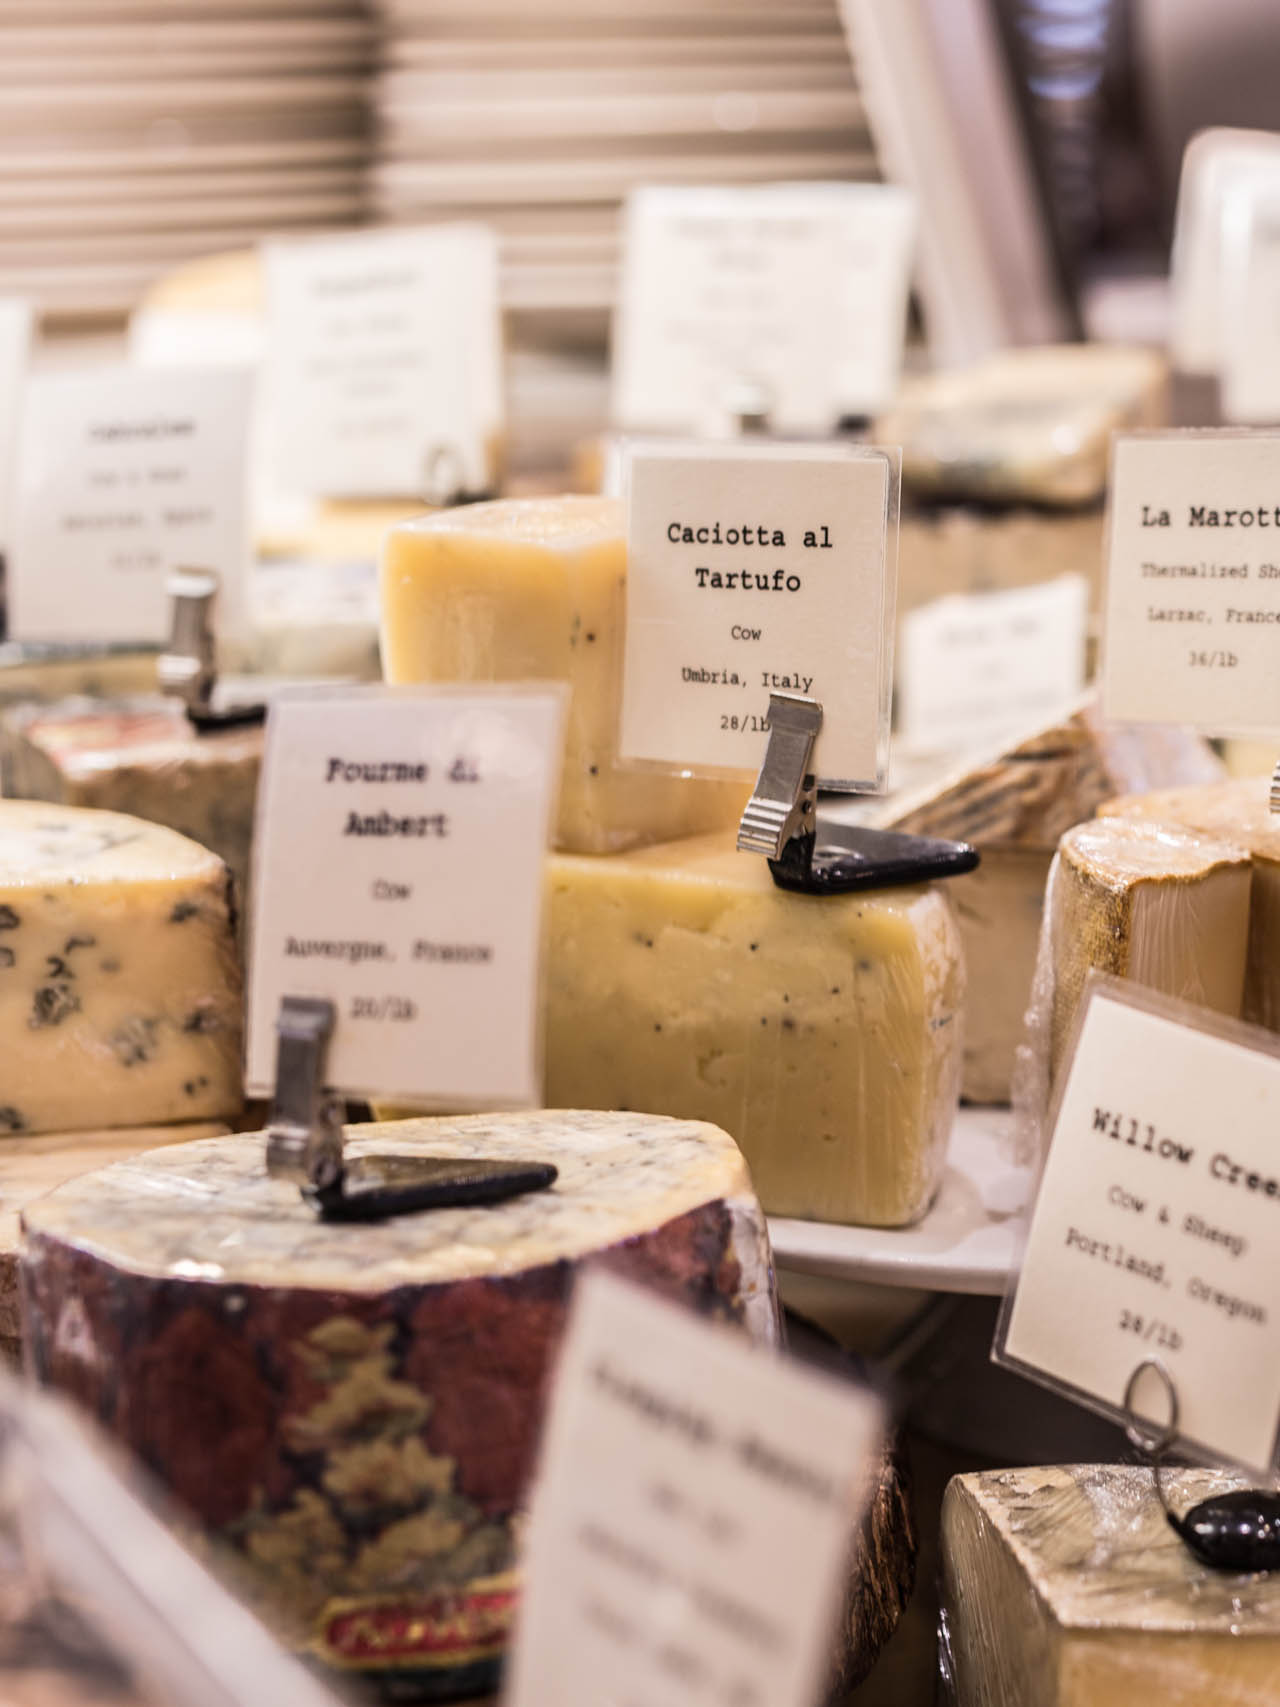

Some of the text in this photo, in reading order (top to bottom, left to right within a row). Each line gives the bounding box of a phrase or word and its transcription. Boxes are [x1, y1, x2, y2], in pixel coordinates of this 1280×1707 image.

[1142, 506, 1171, 527] La
[668, 522, 832, 548] Caciotta al
[695, 568, 801, 592] Tartufo
[1142, 563, 1248, 579] Thermalized
[731, 625, 762, 640] Cow
[682, 667, 813, 692] Umbria, Italy
[720, 715, 771, 732] 28/lb
[326, 758, 428, 784] Fourme
[344, 811, 448, 837] Ambert
[373, 880, 411, 900] Cow
[412, 939, 493, 964] France
[1093, 1108, 1194, 1164] Willow
[1111, 1186, 1146, 1213] Cow
[1184, 1216, 1247, 1258] Sheep
[1188, 1278, 1268, 1326] Oregon
